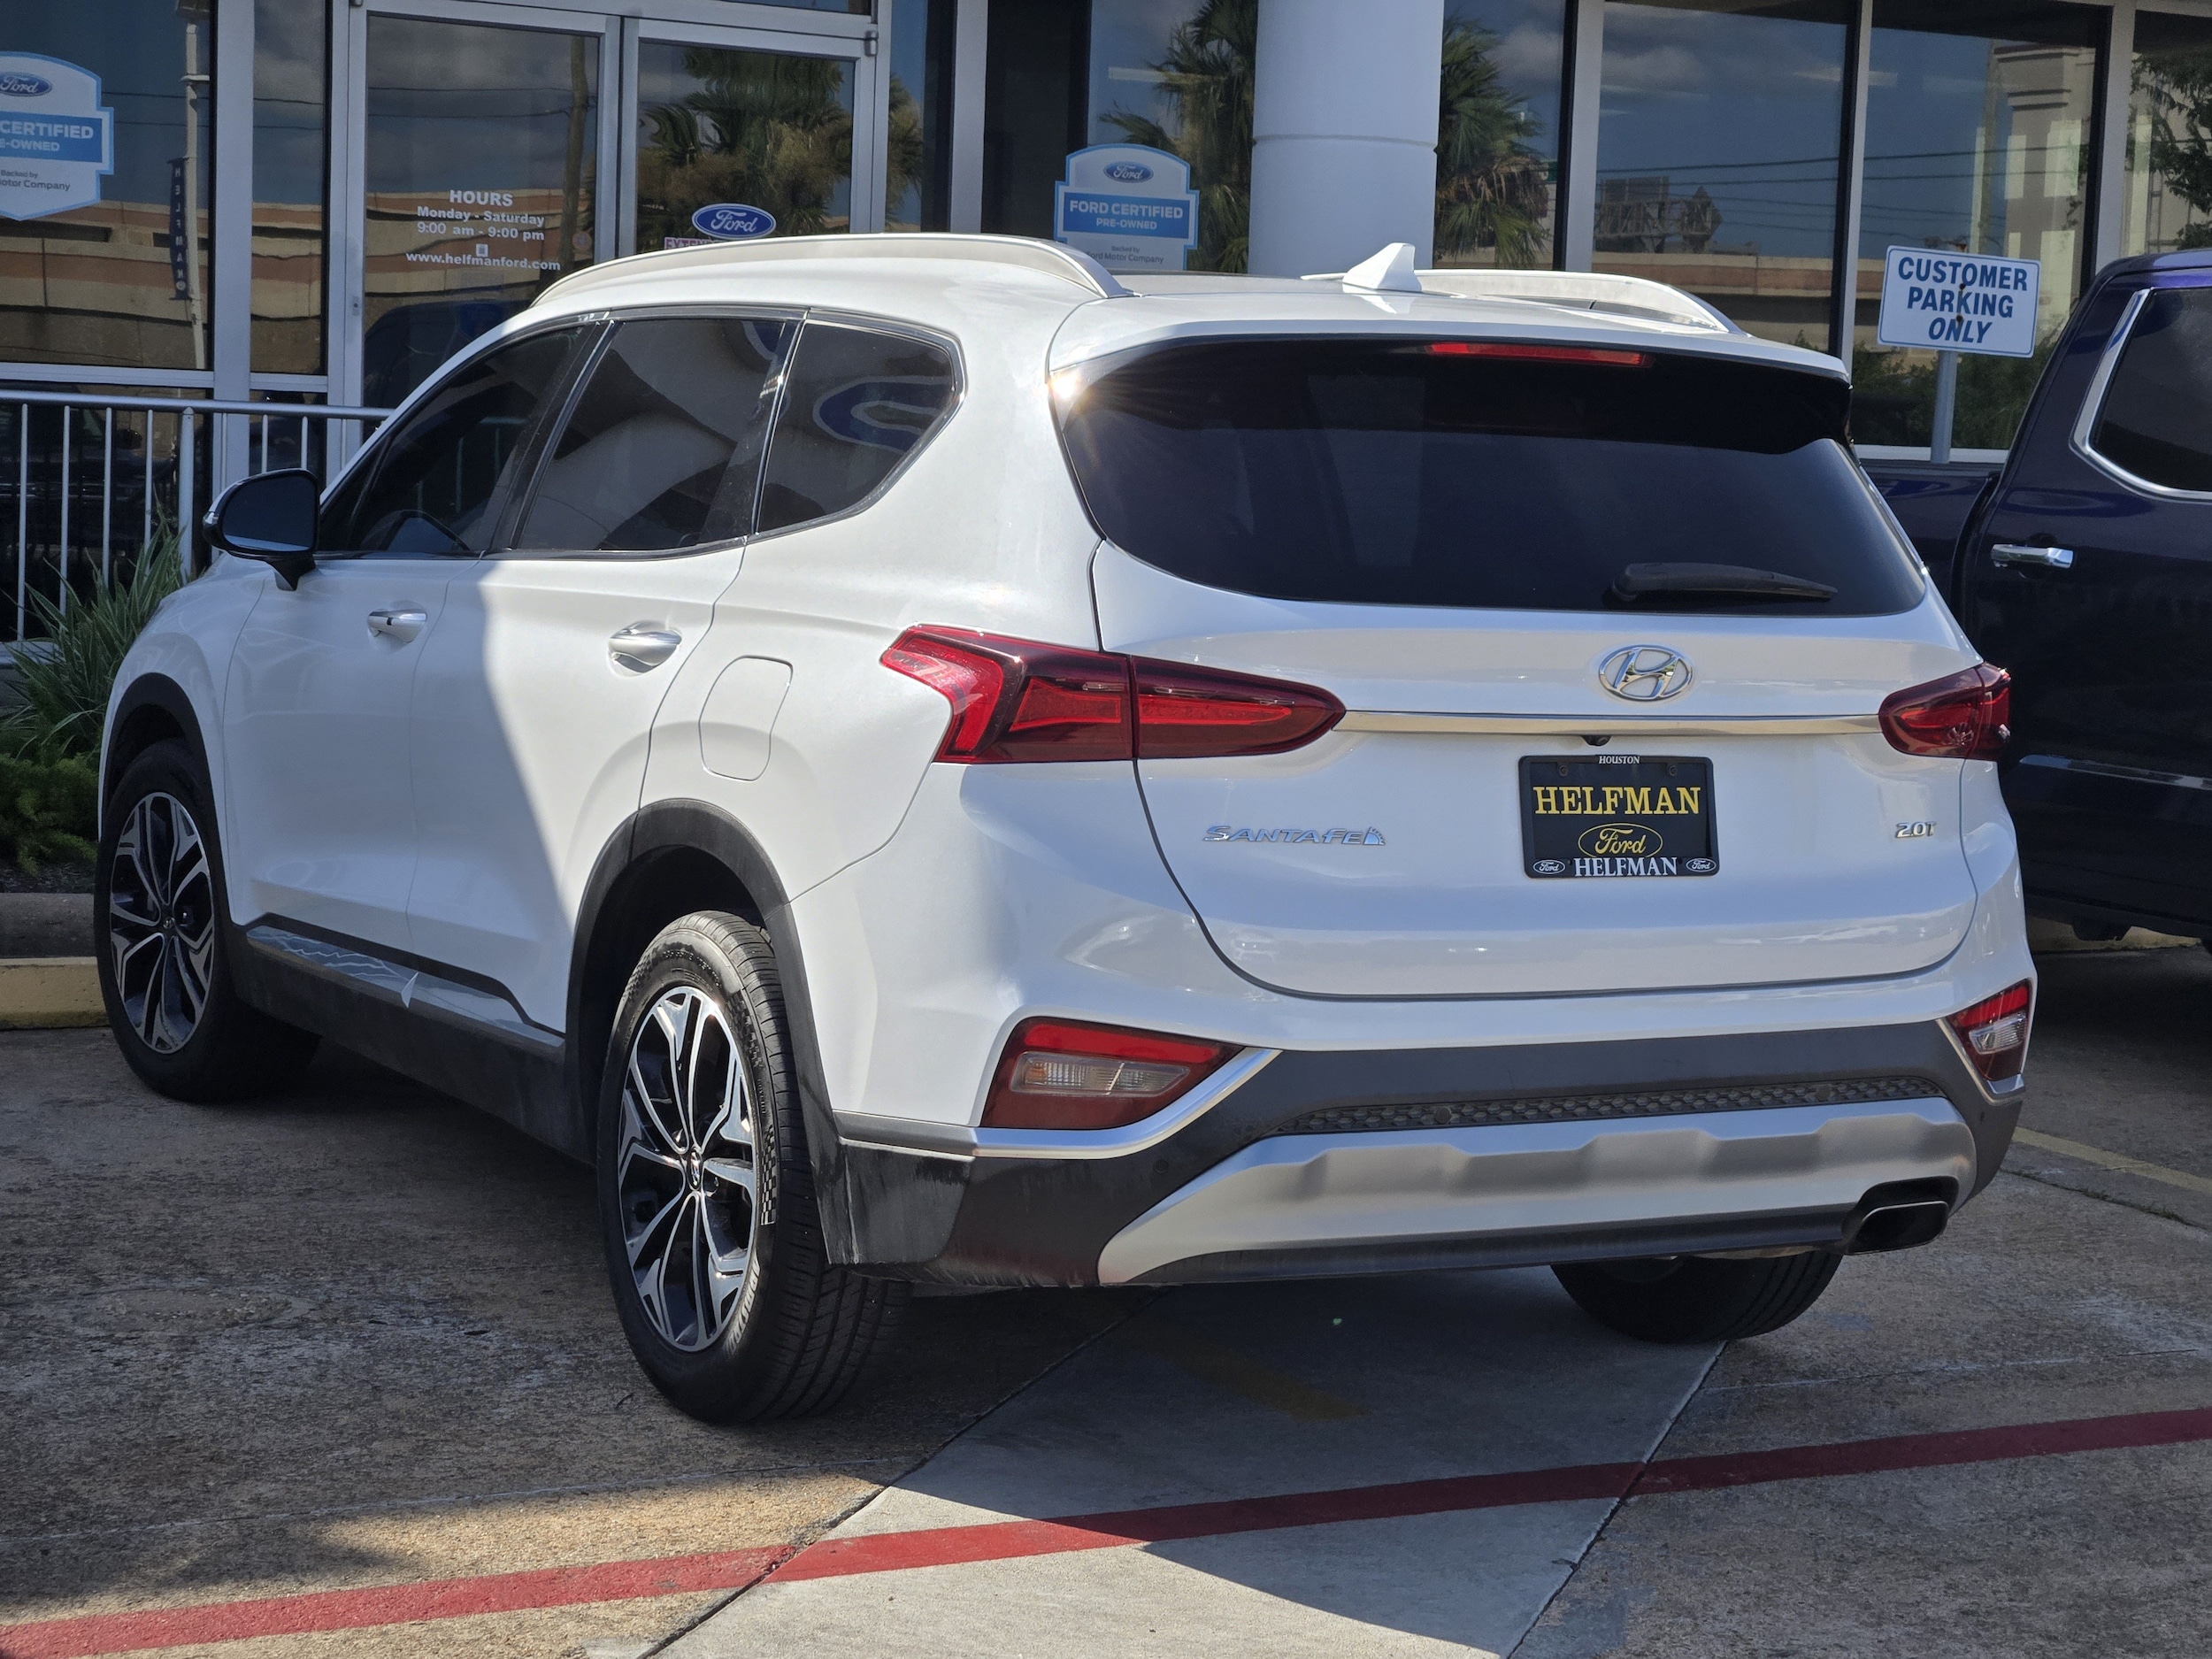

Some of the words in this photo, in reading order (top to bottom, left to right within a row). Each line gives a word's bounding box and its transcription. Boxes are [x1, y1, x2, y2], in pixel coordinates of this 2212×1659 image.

[0, 75, 39, 93] Ford
[0, 120, 94, 139] CERTIFIED
[1113, 164, 1142, 180] Ford
[24, 180, 71, 192] Company
[449, 189, 513, 207] HOURS
[417, 206, 471, 222] Monday
[483, 211, 544, 227] Saturday
[1070, 200, 1109, 214] FORD
[1111, 203, 1183, 219] CERTIFIED
[710, 210, 758, 232] Ford
[1096, 218, 1157, 230] PRE-OWNED
[418, 222, 446, 234] 9:00
[453, 227, 474, 236] am
[488, 227, 518, 239] 9:00
[523, 232, 544, 242] pm
[406, 253, 560, 271] www.helfmanford.com
[1128, 254, 1164, 264] Company
[1899, 257, 2028, 291] CUSTOMER
[1908, 286, 2014, 319] PARKING
[1929, 318, 1992, 343] ONLY
[1599, 756, 1640, 764] HOUSTON
[1533, 787, 1701, 814] HELFMAN
[1594, 827, 1647, 854] Ford
[1539, 862, 1559, 872] Ford
[1573, 856, 1678, 876] HELFMAN
[1691, 860, 1710, 870] Ford
